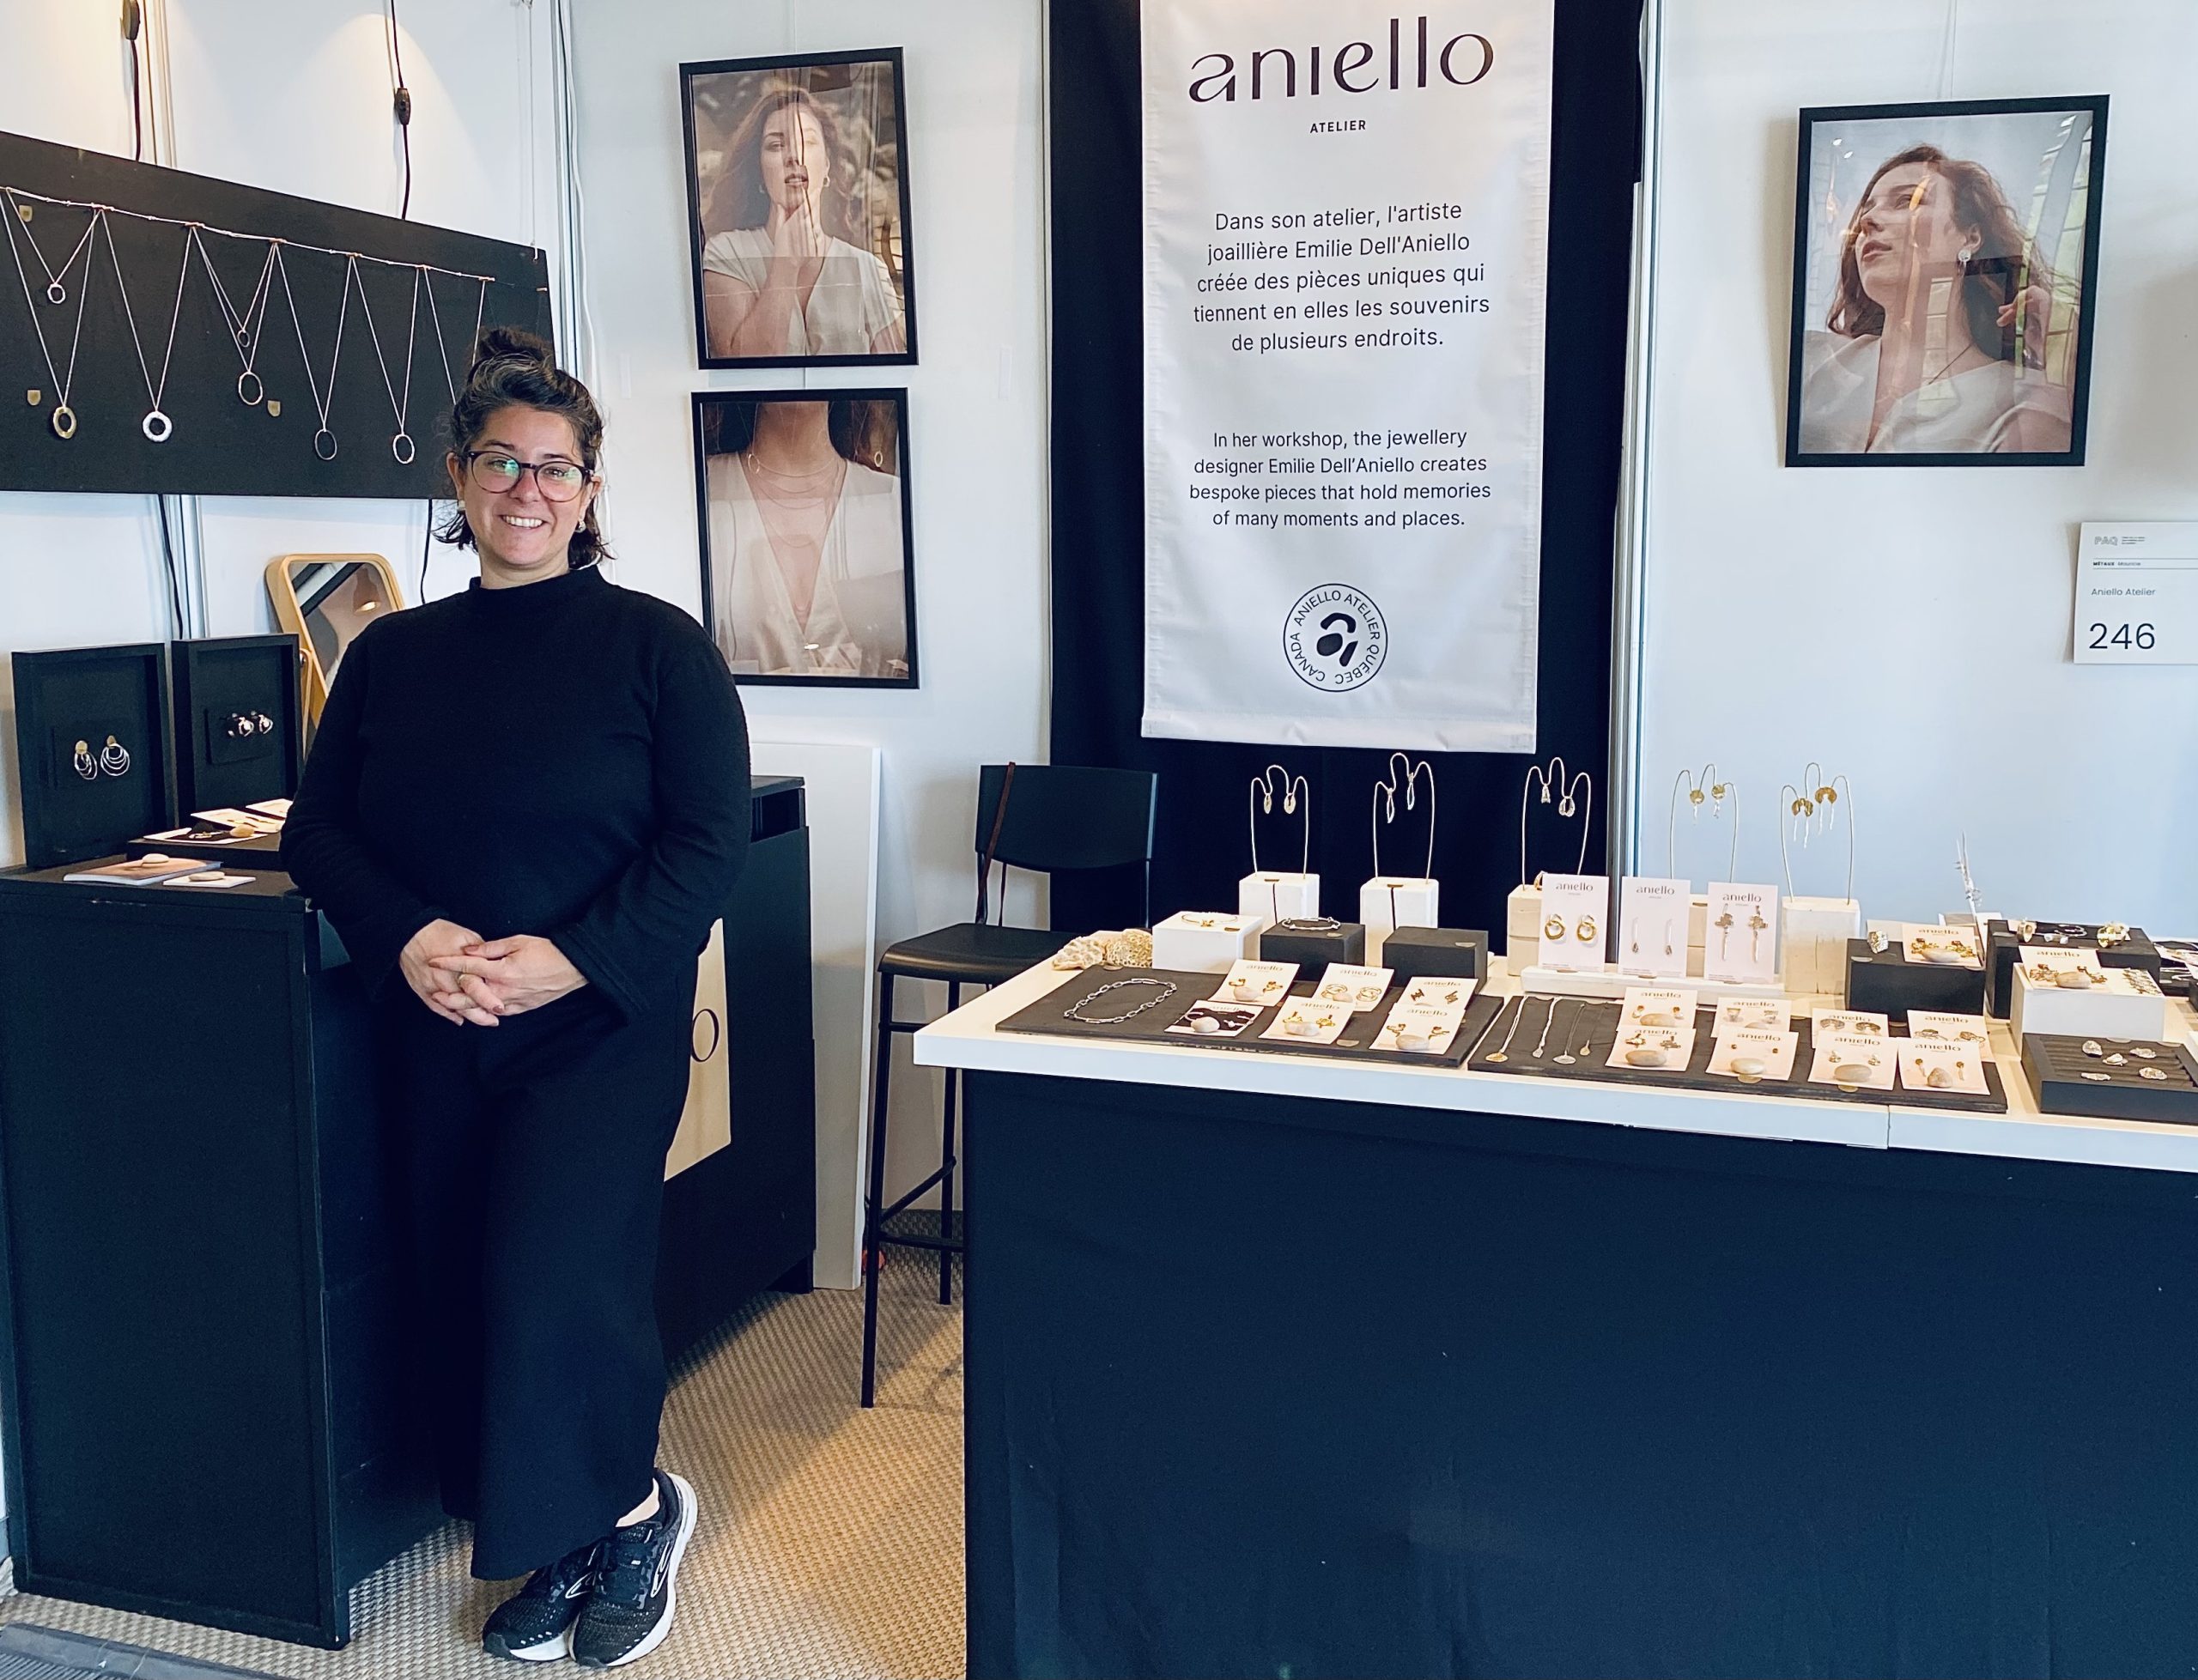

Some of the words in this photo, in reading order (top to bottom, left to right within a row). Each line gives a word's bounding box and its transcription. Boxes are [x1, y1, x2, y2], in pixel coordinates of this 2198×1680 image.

[1189, 15, 1494, 102] aniello
[1310, 119, 1367, 134] ATELIER
[1216, 212, 1265, 232] Dans
[1271, 209, 1306, 229] son
[1313, 207, 1381, 228] atelier,
[1387, 203, 1462, 223] l'artiste
[1206, 240, 1289, 265] joaillière
[1296, 238, 1353, 259] Emilie
[1360, 233, 1471, 256] Dell'Aniello
[1197, 271, 1248, 293] créée
[1254, 272, 1290, 291] des
[1296, 270, 1361, 293] pièces
[1368, 266, 1446, 288] uniques
[1454, 263, 1485, 288] qui
[1193, 302, 1266, 323] tiennent
[1273, 304, 1297, 320] en
[1304, 300, 1350, 318] elles
[1356, 299, 1382, 318] les
[1389, 295, 1491, 316] souvenirs
[1232, 333, 1254, 352] de
[1260, 331, 1348, 355] plusieurs
[1354, 327, 1445, 349] endroits.
[1213, 432, 1228, 448] In
[1232, 431, 1258, 447] her
[1262, 431, 1348, 450] workshop,
[1353, 430, 1382, 446] the
[1387, 428, 1468, 450] jewellery
[1194, 458, 1264, 478] designer
[1269, 458, 1315, 474] Emilie
[1420, 456, 1488, 472] creates
[1190, 484, 1260, 504] bespoke
[1265, 484, 1317, 504] pieces
[1321, 483, 1355, 500] that
[1360, 483, 1398, 500] hold
[1404, 482, 1492, 500] memories
[1213, 510, 1230, 525] of
[1235, 512, 1279, 530] many
[1284, 511, 1359, 527] moments
[1364, 510, 1397, 526] and
[1402, 509, 1466, 530] places.
[2091, 587, 2123, 596] Aniello
[2125, 587, 2156, 596] Atelier
[1294, 590, 1341, 627] ANIELLO
[1344, 593, 1381, 640] ATELIER
[2089, 622, 2155, 650] 246
[1290, 633, 1326, 682] CANADA
[1334, 644, 1380, 685] QUÉBEC
[1555, 882, 1594, 892] aniello
[1636, 885, 1675, 895] aniello
[1722, 893, 1762, 903] aniello
[1339, 968, 1378, 977] aniello
[1406, 1008, 1448, 1017] aniello
[1835, 1037, 1880, 1046] aniello
[1915, 1043, 1961, 1052] aniello
